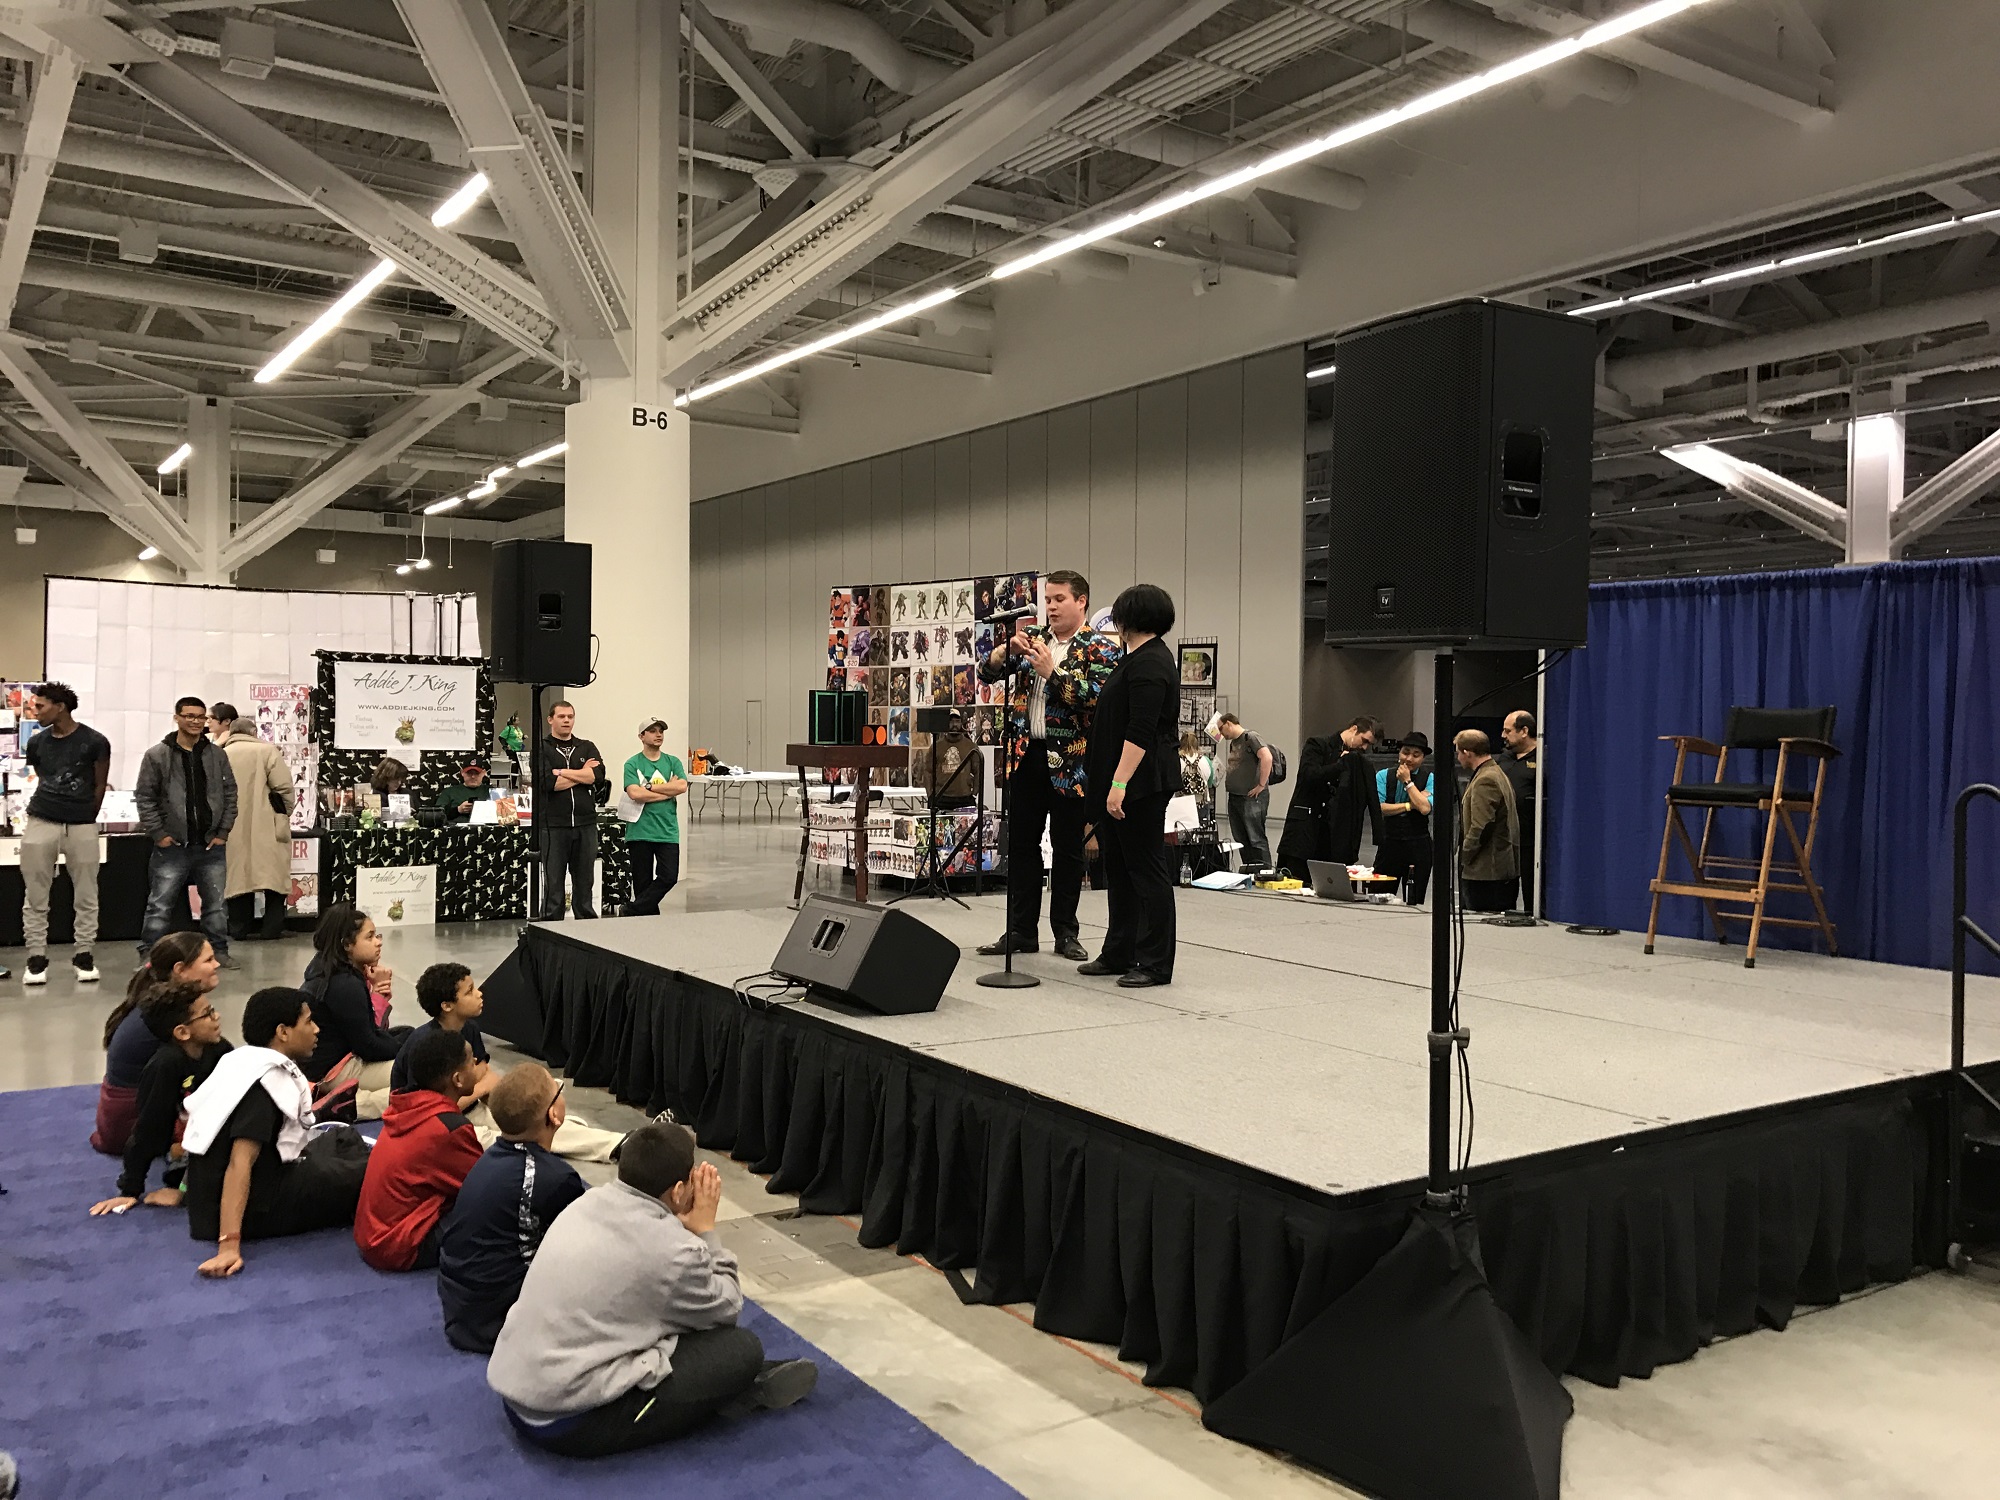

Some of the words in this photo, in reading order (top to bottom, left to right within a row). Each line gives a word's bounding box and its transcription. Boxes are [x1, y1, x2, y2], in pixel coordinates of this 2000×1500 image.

[632, 407, 668, 430] B-6
[353, 669, 400, 690] Addie
[388, 674, 418, 695] J.
[412, 674, 458, 706] King
[357, 704, 455, 712] WWW.ADDIEJKING.COM
[370, 871, 396, 883] Addie
[403, 871, 428, 889] King
